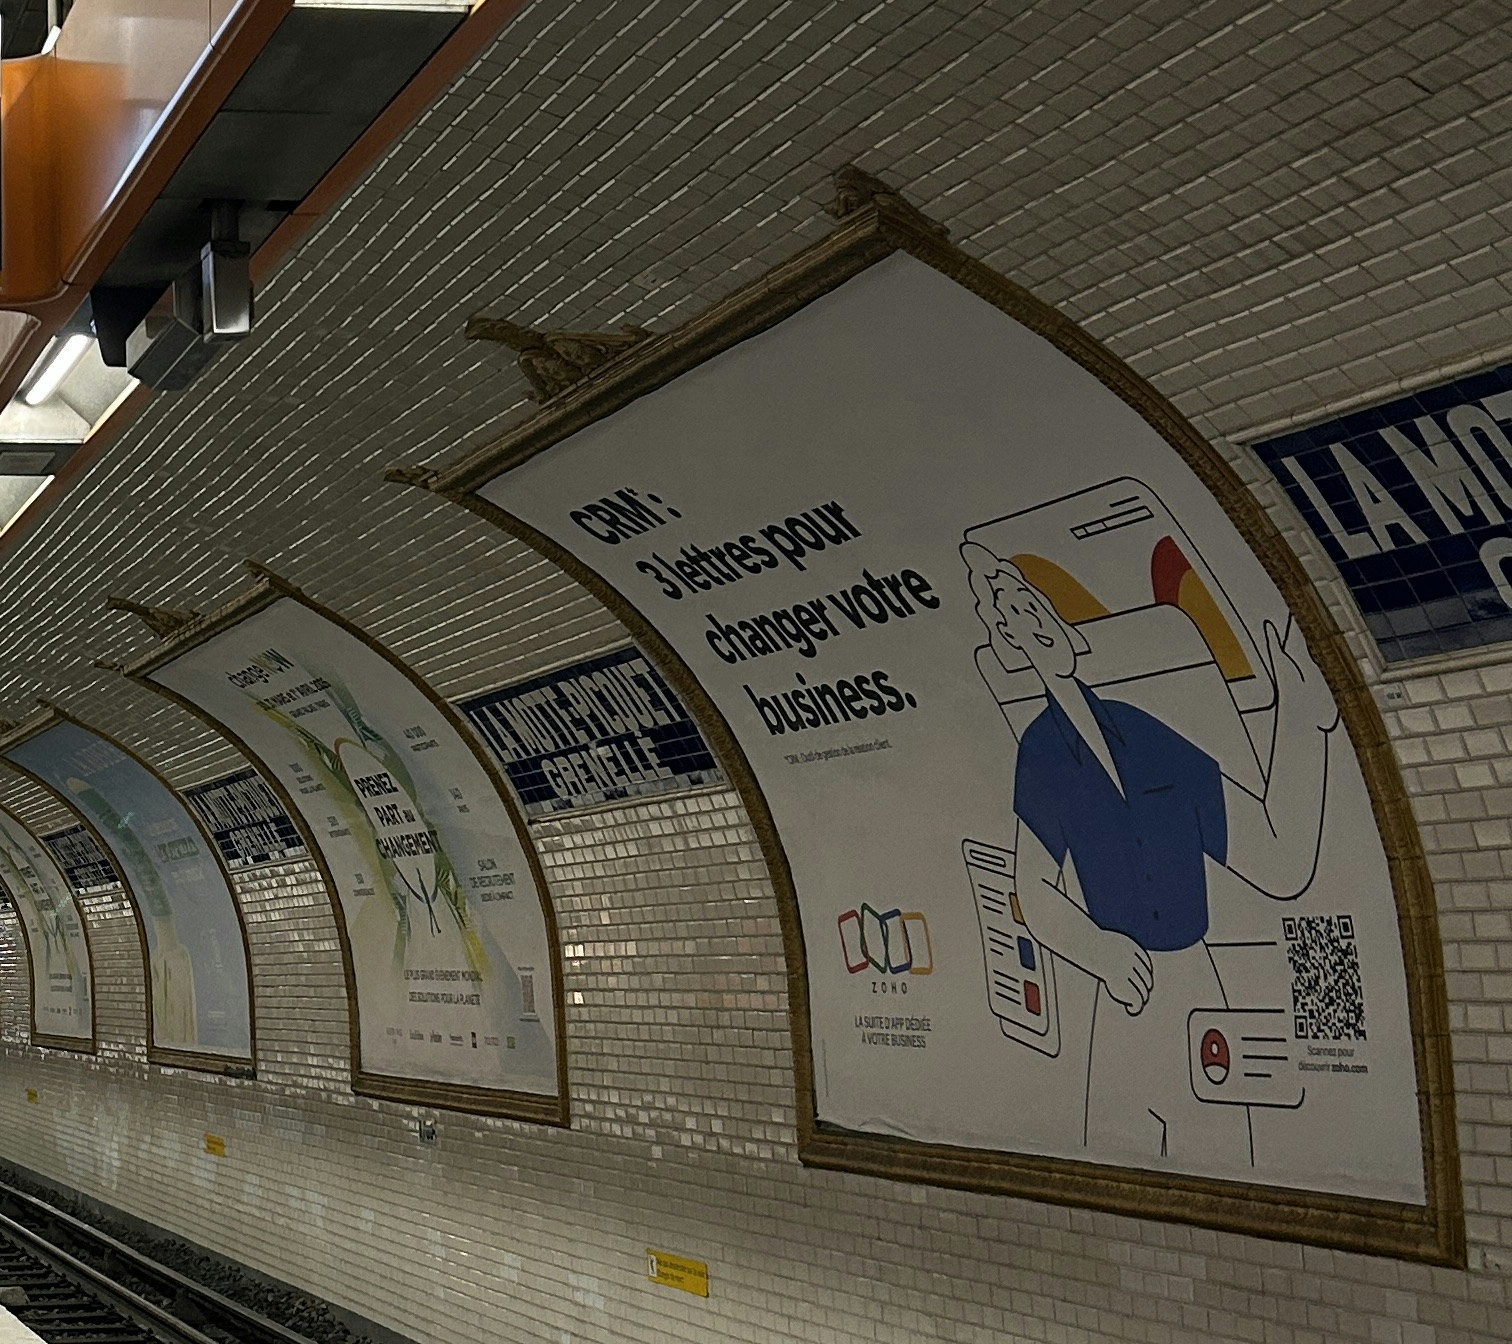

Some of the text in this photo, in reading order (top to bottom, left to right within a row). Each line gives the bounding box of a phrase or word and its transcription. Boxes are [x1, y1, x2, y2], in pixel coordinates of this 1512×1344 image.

[1281, 442, 1431, 559] LA
[635, 500, 862, 600] 3 lettres pour
[705, 568, 941, 664] changer votre
[225, 648, 295, 689] changeNOW
[469, 657, 682, 763] LA MOTTE-PICQUET
[742, 670, 918, 736] business.
[354, 772, 399, 798] PRENEZ
[541, 736, 673, 800] GRENELLE
[374, 803, 405, 827] PART
[402, 809, 416, 822] au
[375, 830, 443, 859] CHANGEMENT
[872, 981, 908, 994] ZOHO
[891, 1033, 926, 1049] BUSINESS
